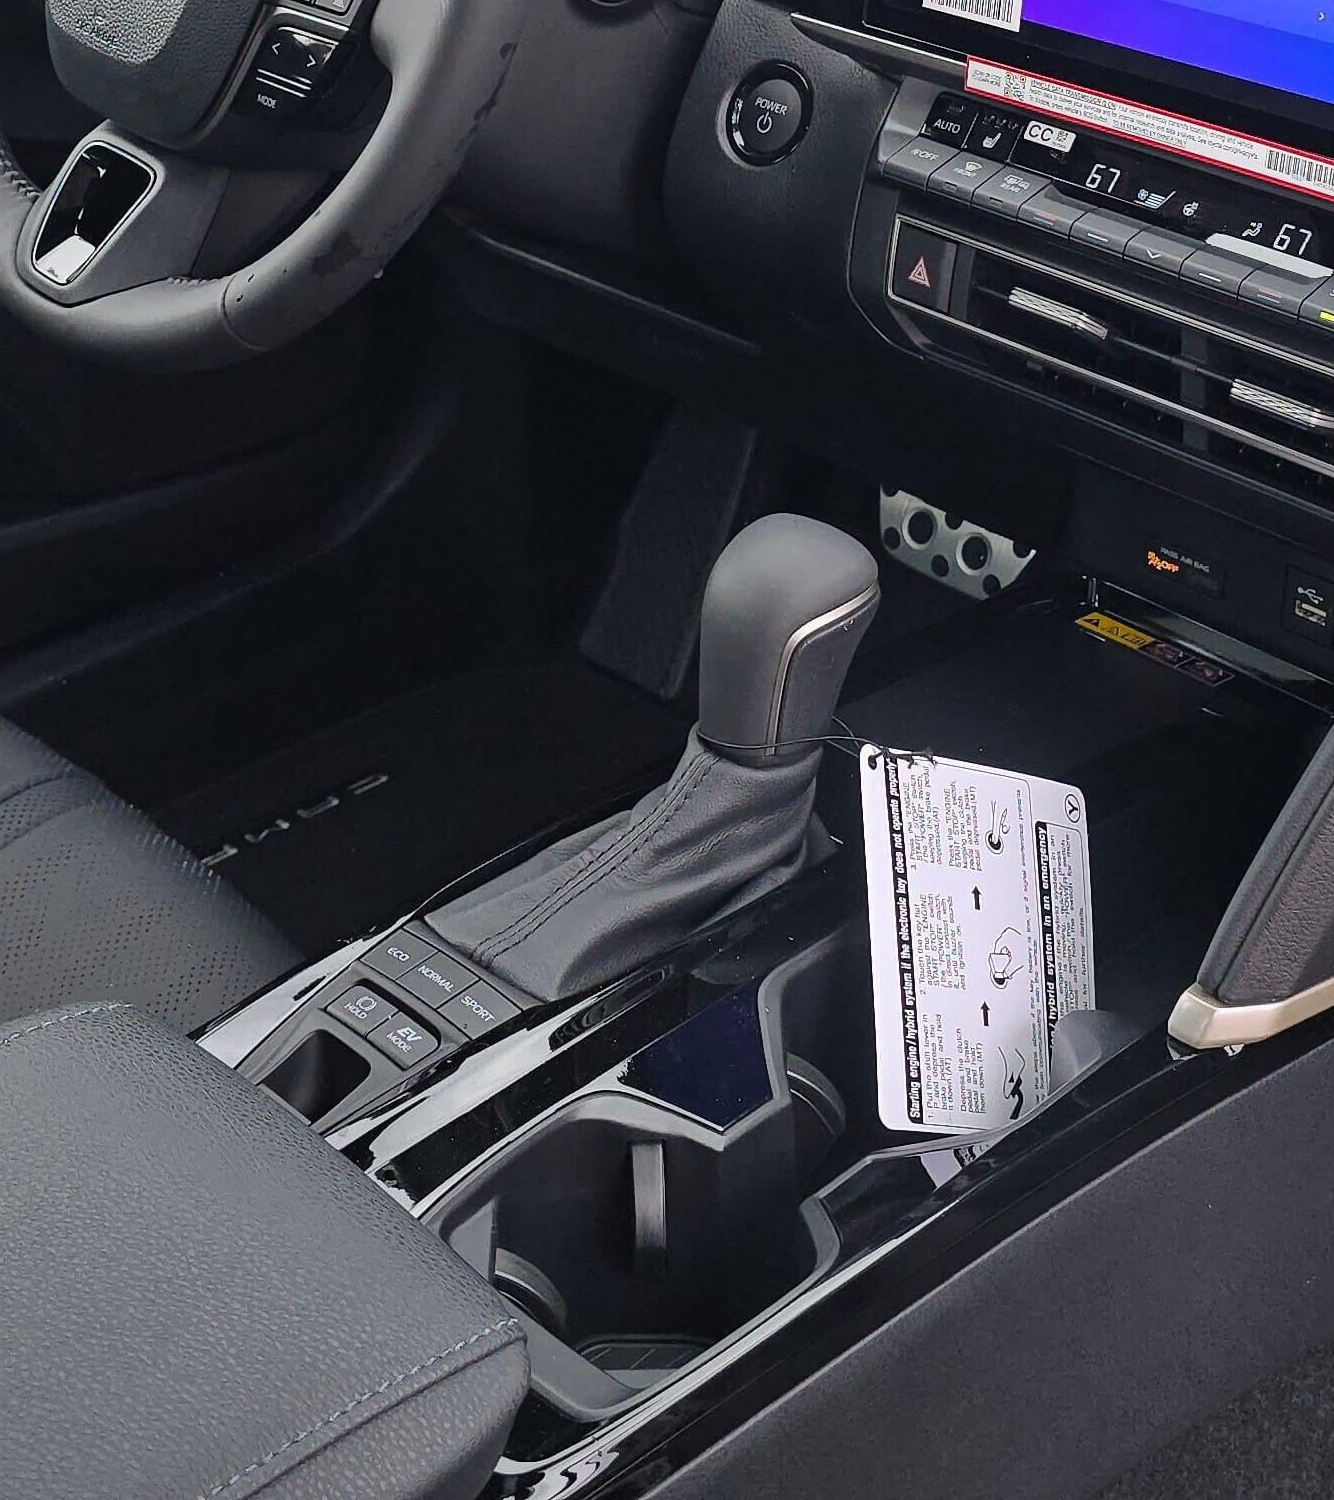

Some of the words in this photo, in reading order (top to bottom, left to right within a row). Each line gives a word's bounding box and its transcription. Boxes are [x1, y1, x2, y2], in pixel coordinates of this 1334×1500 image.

[755, 96, 788, 116] POWER
[933, 118, 961, 134] AUTO
[1029, 124, 1054, 142] CC
[919, 151, 939, 161] OFF
[953, 167, 977, 177] FRONT
[1085, 164, 1121, 193] 67
[1273, 223, 1314, 255] 67
[1194, 561, 1210, 572] BAG
[1068, 800, 1078, 815] Y
[893, 834, 902, 848] not
[895, 852, 905, 873] does
[1037, 827, 1048, 889] emergency
[1043, 896, 1050, 910] an
[897, 897, 909, 940] electronic
[1043, 916, 1052, 926] in
[387, 947, 410, 962] ECO
[901, 944, 910, 958] the
[1045, 934, 1054, 975] system
[417, 965, 455, 993] NORMAL
[461, 996, 495, 1022] SPORT
[1047, 982, 1057, 1019] hybrid
[343, 1002, 368, 1020] HOLD
[387, 1033, 411, 1052] MODE
[397, 1026, 423, 1042] EV
[909, 1082, 920, 1118] Starting
